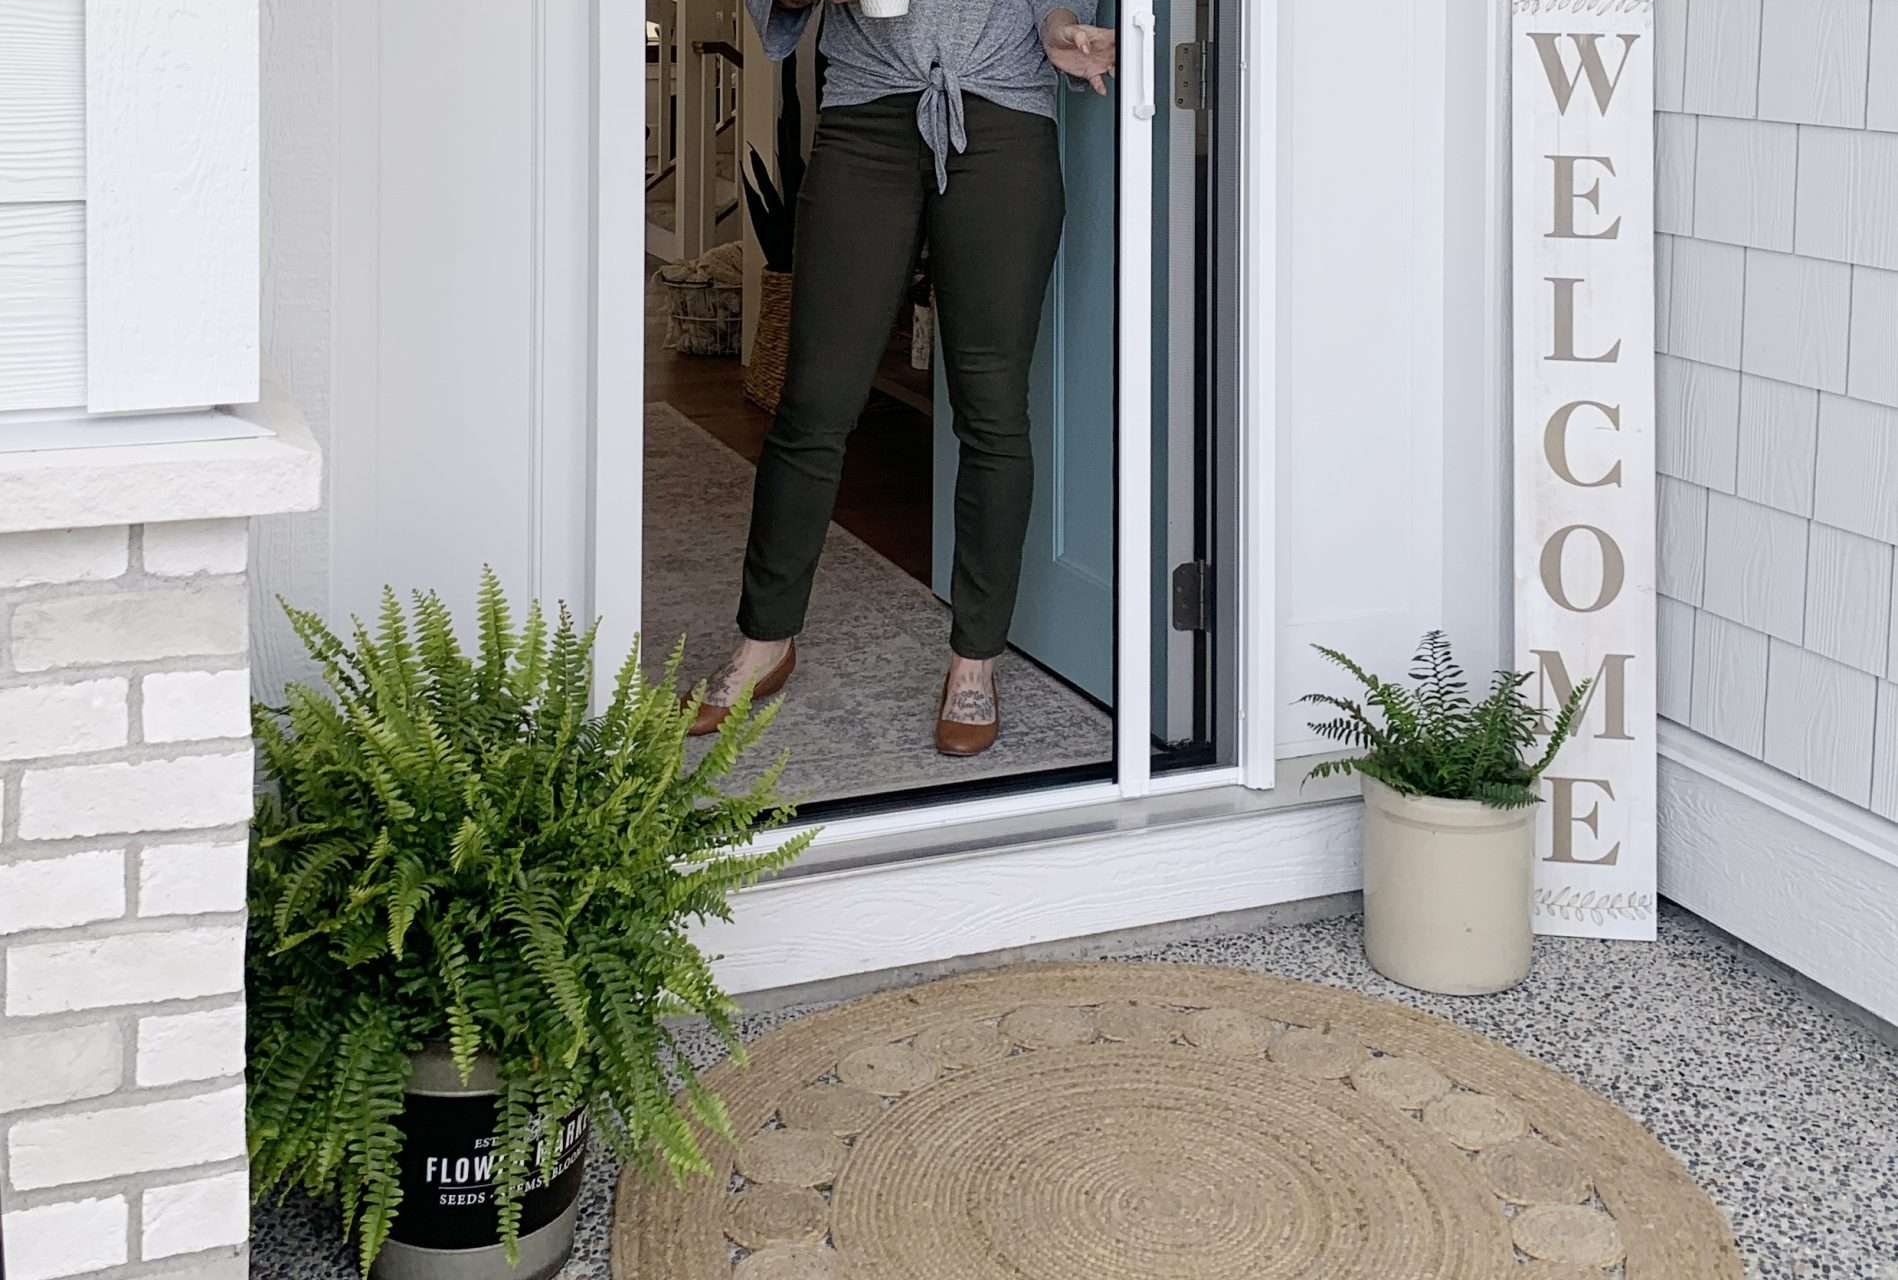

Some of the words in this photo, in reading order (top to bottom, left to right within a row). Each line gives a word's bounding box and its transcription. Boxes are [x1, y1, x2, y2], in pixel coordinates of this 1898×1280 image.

[1526, 32, 1641, 867] WELCOME
[425, 1154, 523, 1184] FLOW
[439, 1191, 486, 1206] SEEDS
